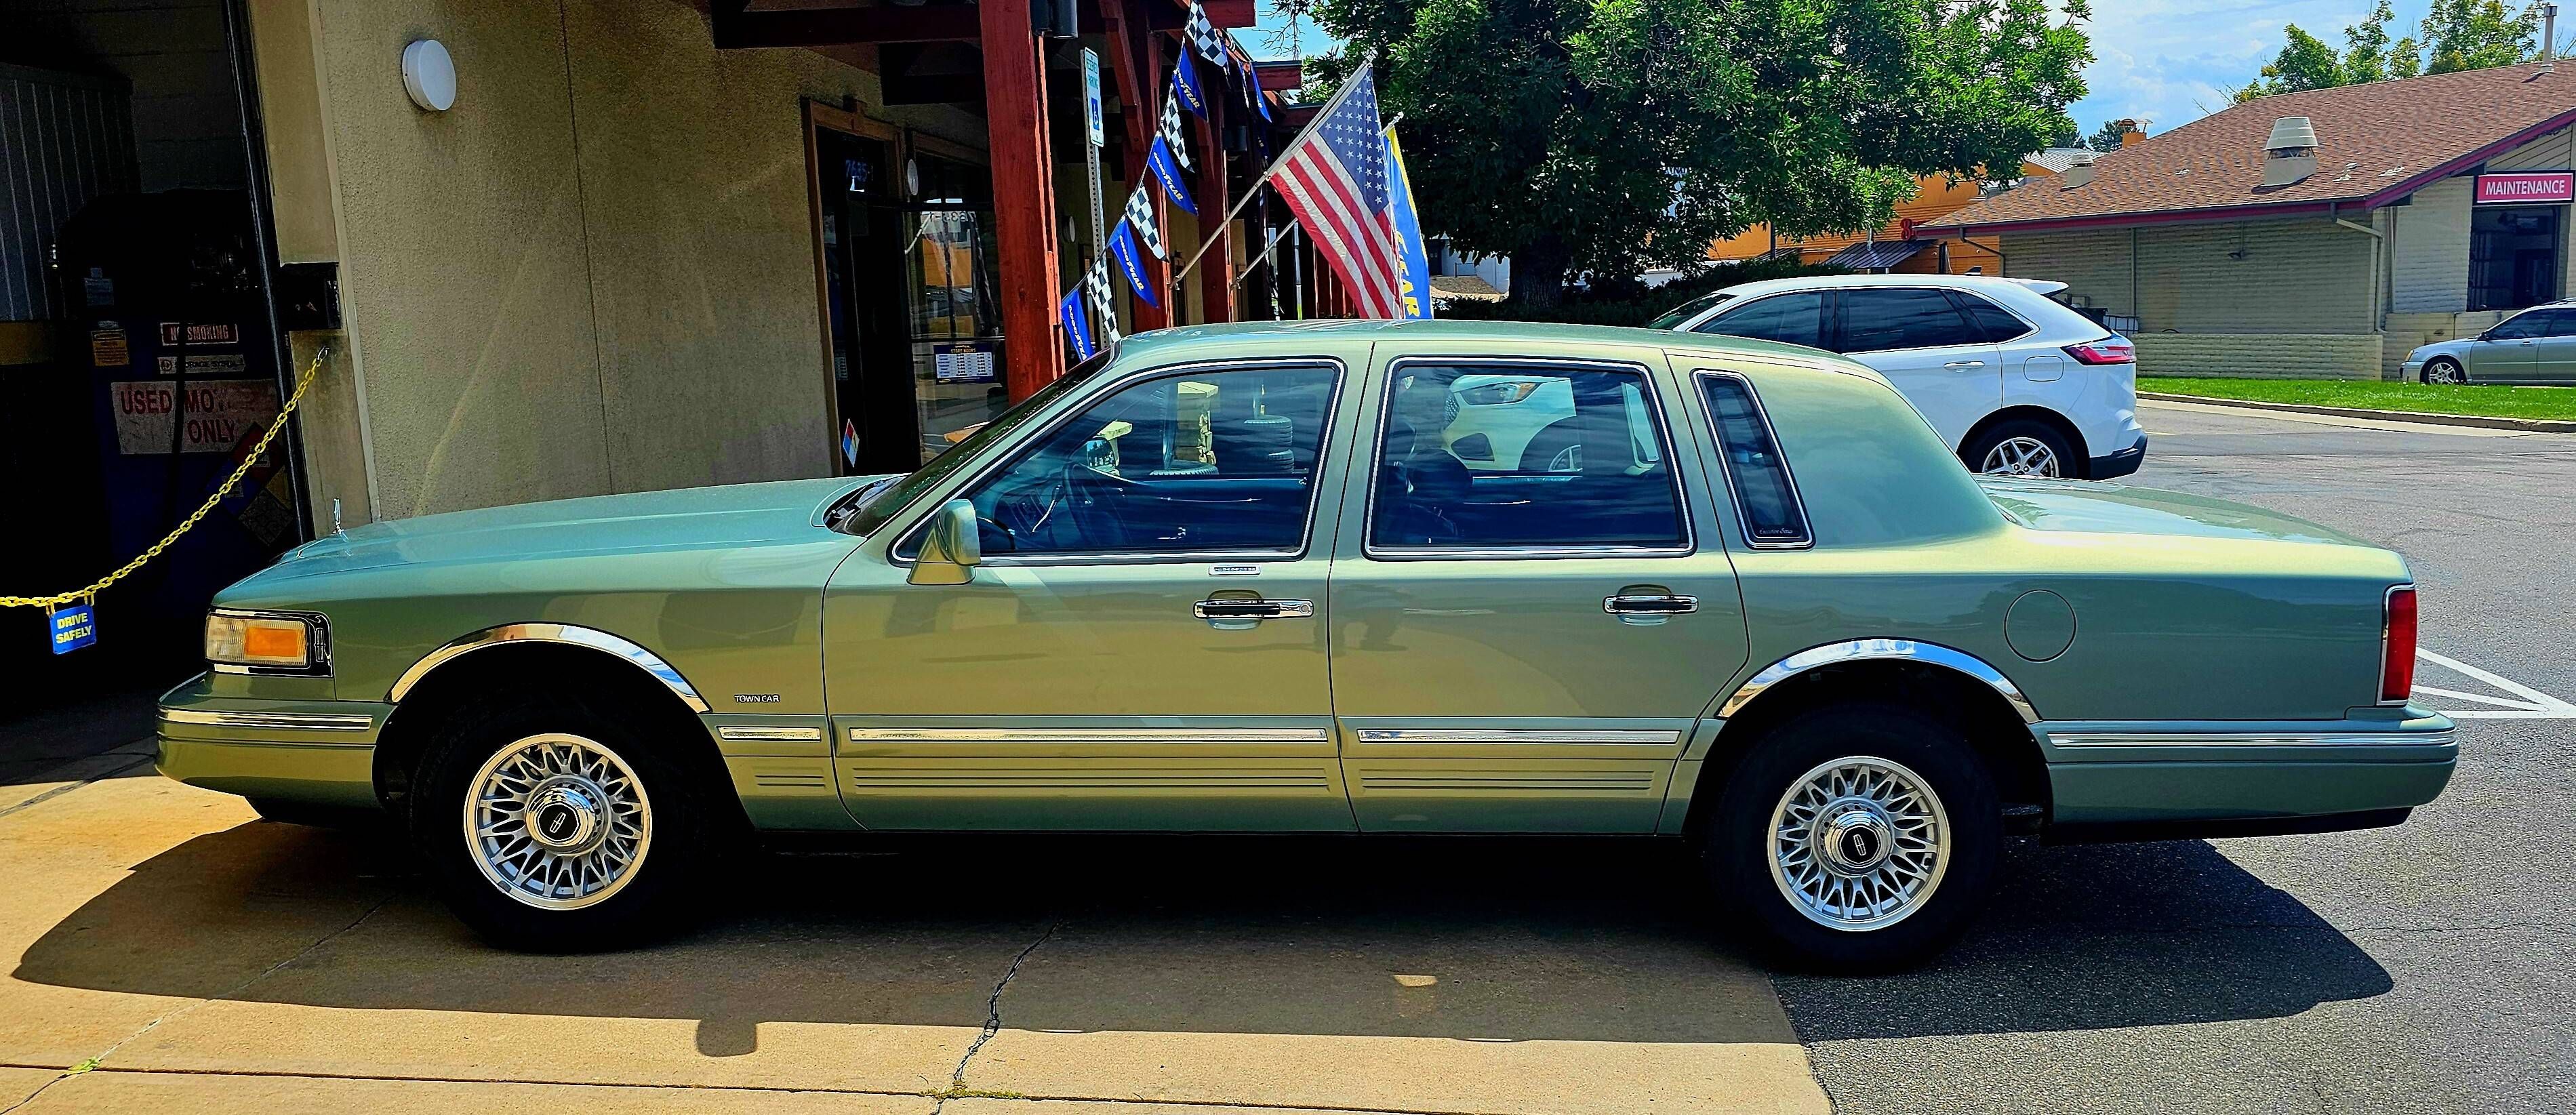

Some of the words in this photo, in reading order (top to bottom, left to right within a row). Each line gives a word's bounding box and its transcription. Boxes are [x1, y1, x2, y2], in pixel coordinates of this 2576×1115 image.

[1178, 69, 1201, 109] OODYEAR
[1153, 152, 1184, 201] GOODYEAR
[2486, 180, 2565, 196] MAINTENANCE
[1119, 235, 1144, 291] GOODYEAR
[187, 325, 228, 340] SMOKING
[1068, 304, 1087, 361] GOODYEA
[120, 390, 173, 415] USED
[187, 418, 236, 444] ONLY
[56, 612, 89, 630] DRIVE
[55, 625, 92, 644] SAFELY
